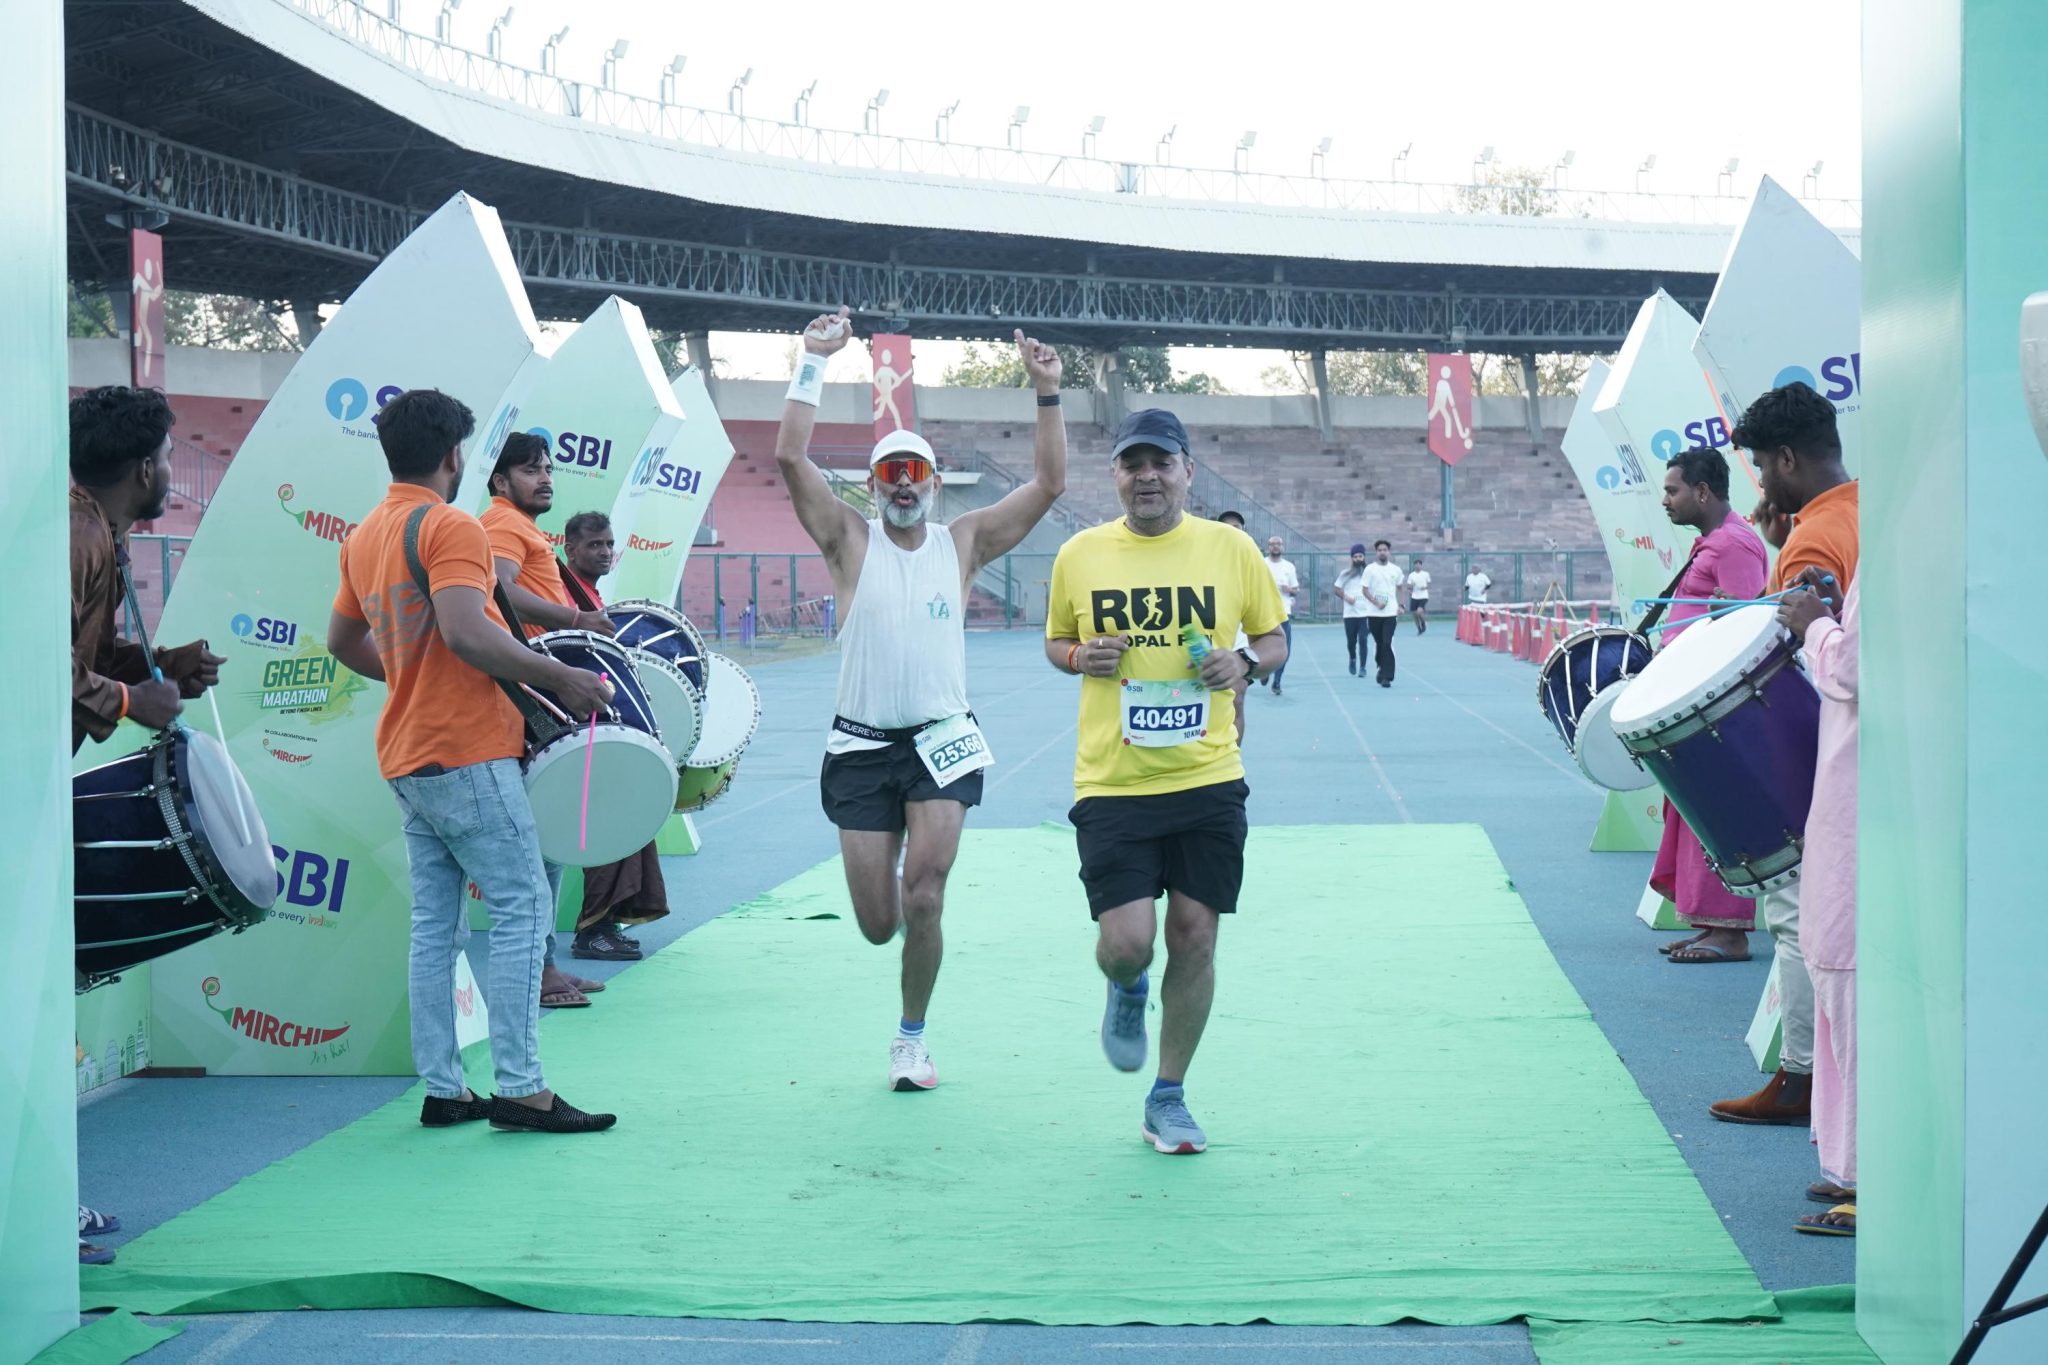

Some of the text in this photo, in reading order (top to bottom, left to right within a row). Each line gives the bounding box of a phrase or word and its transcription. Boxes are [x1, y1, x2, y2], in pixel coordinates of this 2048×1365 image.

[1684, 416, 1732, 451] SB
[555, 432, 612, 470] SBI
[656, 462, 701, 494] SBI
[1091, 586, 1216, 633] RUN
[255, 617, 297, 646] SBI
[263, 656, 337, 688] GREEN
[262, 688, 328, 707] MARATHON
[840, 720, 885, 738] TRUEREVO
[1132, 706, 1197, 729] 40491
[272, 748, 304, 763] MIRCHI
[933, 734, 982, 770] 25366
[278, 911, 305, 925] every
[232, 1007, 322, 1048] MIRCHI
